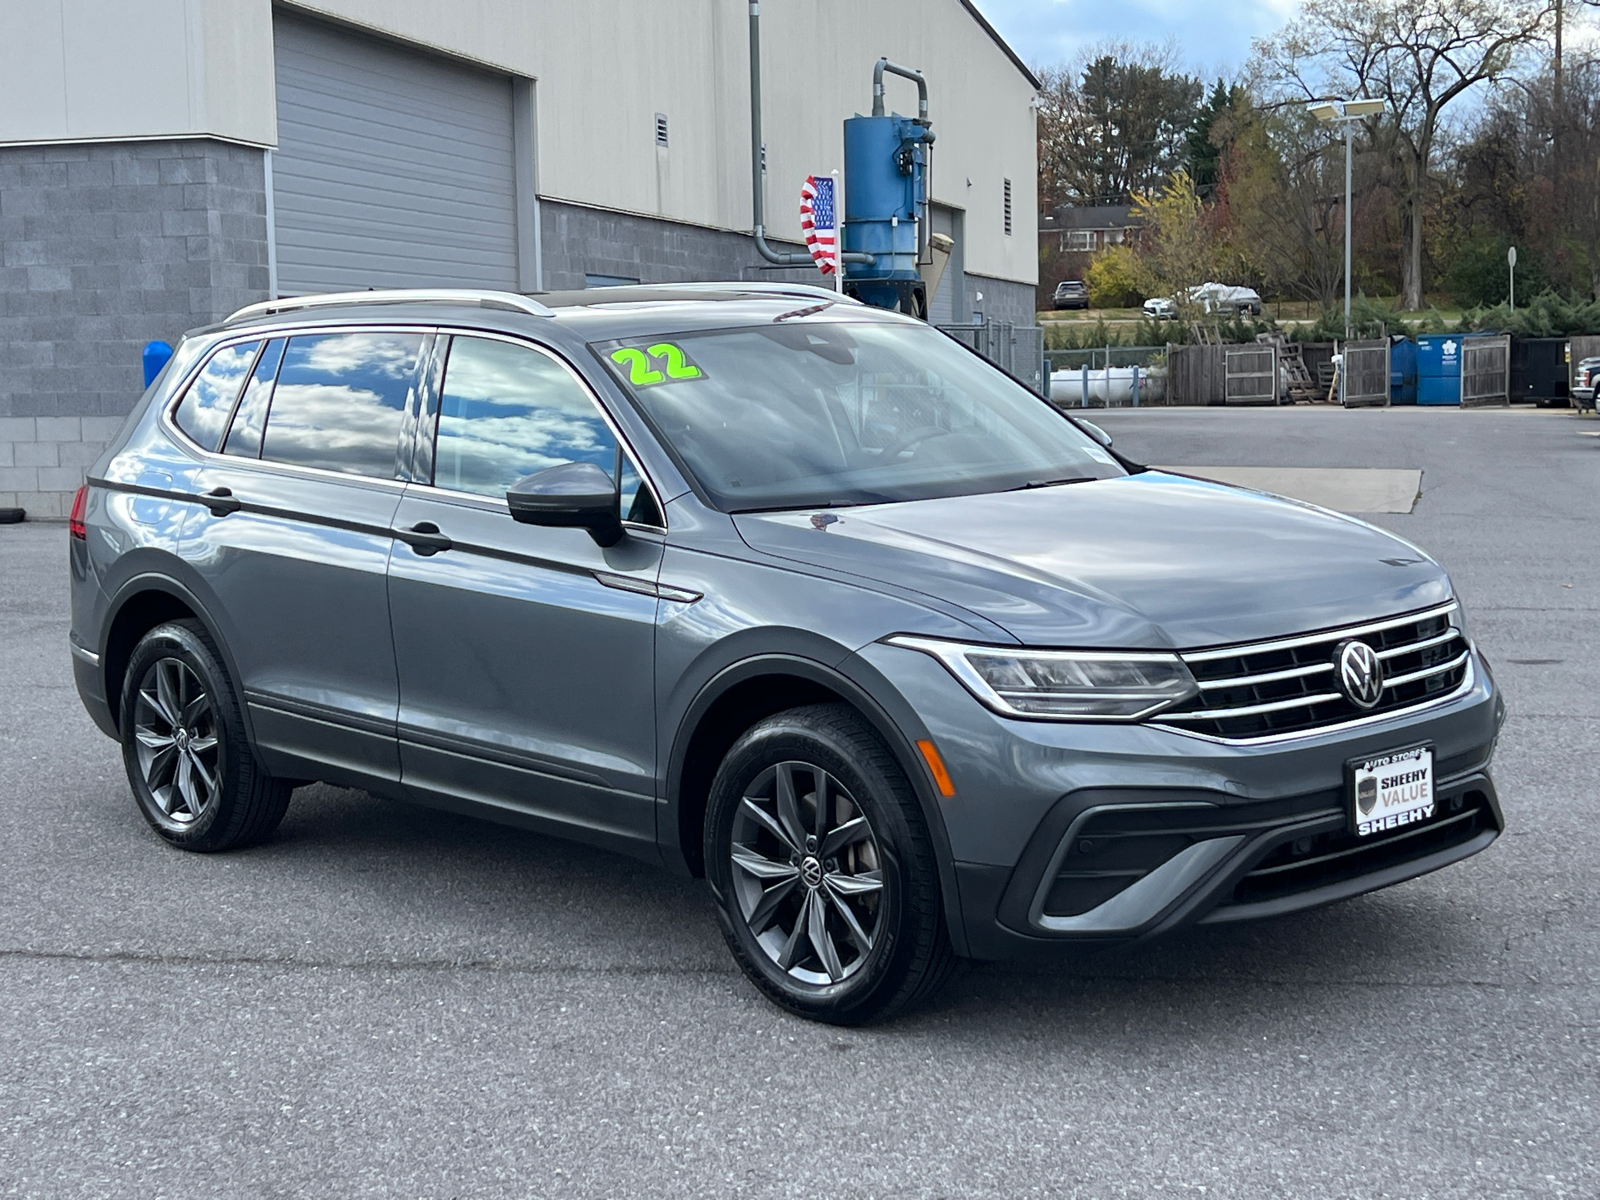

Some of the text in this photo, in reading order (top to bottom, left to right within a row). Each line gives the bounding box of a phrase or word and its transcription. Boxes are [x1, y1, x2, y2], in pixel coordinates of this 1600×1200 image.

[610, 343, 702, 386] 22
[1342, 642, 1383, 707] VW
[1363, 748, 1427, 770] AUTO STORES
[1381, 768, 1428, 790] SHEEHY
[1382, 783, 1428, 807] VALUE
[1358, 804, 1435, 836] SHEEHY
